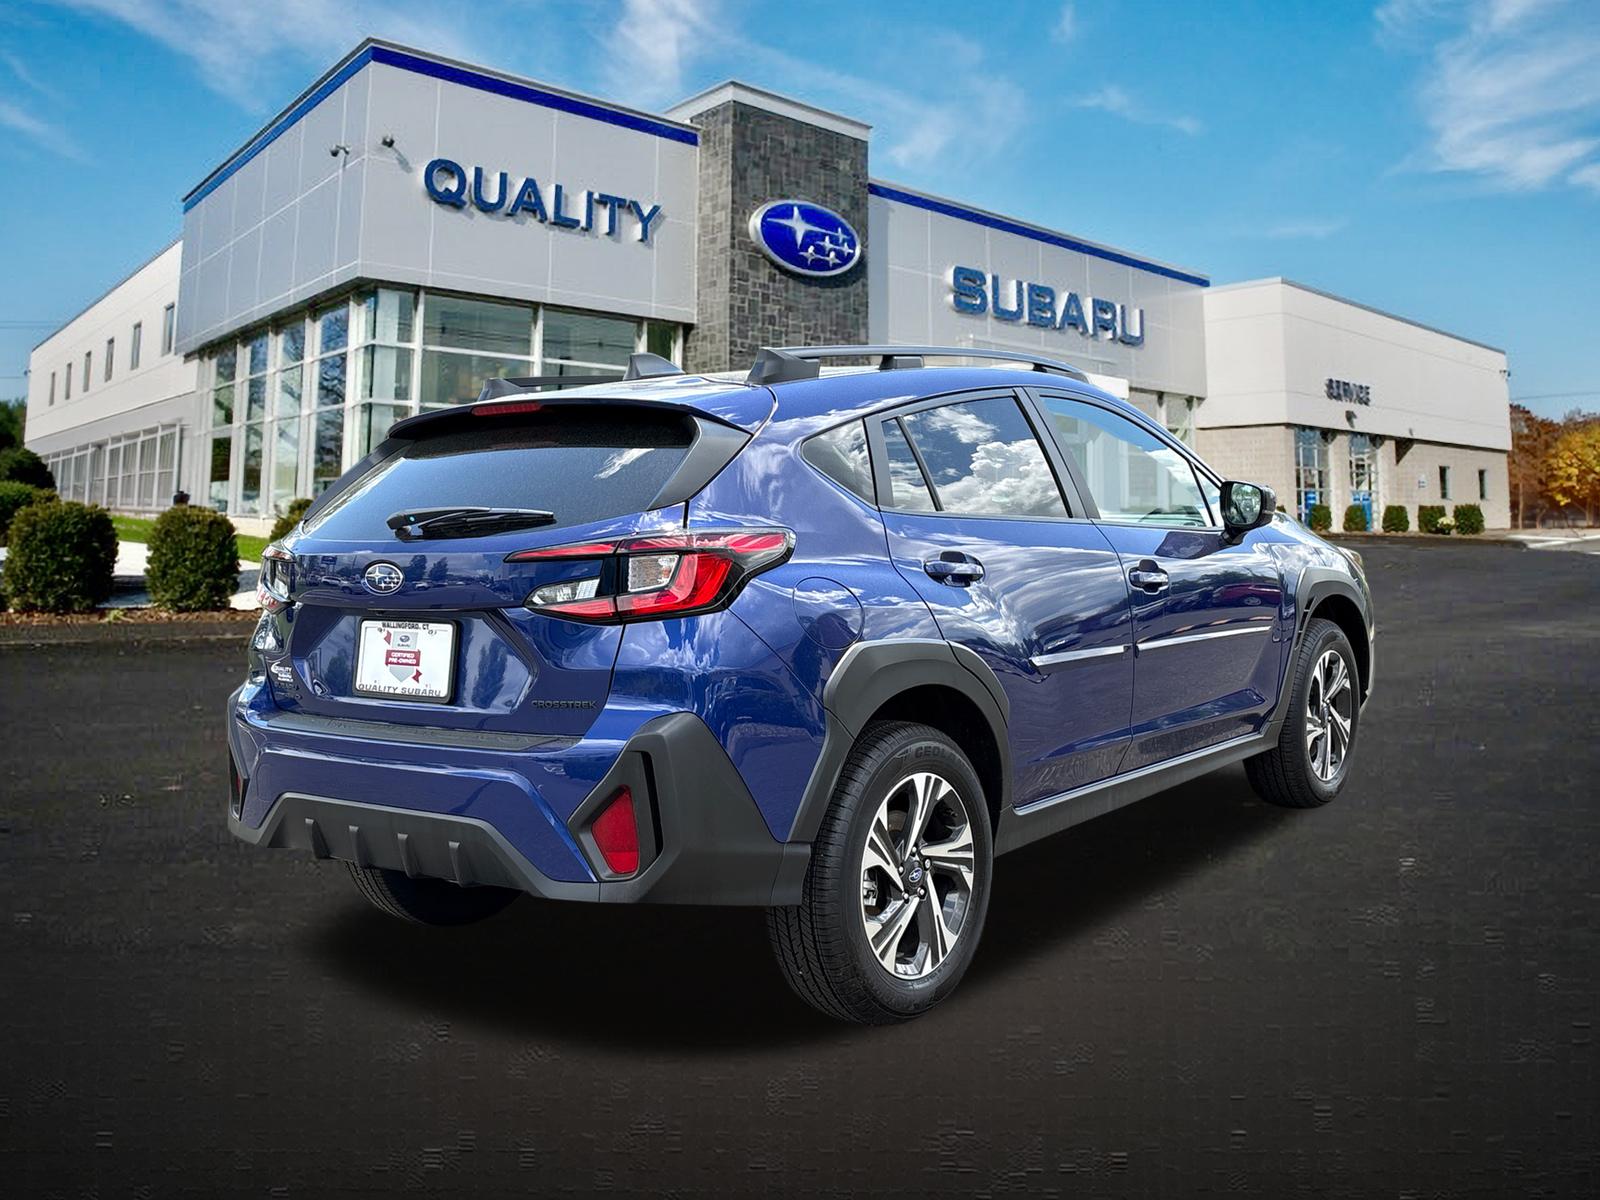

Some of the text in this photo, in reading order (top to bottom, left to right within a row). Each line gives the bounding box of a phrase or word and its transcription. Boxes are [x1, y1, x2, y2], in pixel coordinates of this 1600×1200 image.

[424, 158, 662, 243] QUALITY
[945, 265, 1145, 346] SUBARU
[358, 683, 441, 696] QUALITY SUBARU
[531, 699, 597, 709] CROSSTREK
